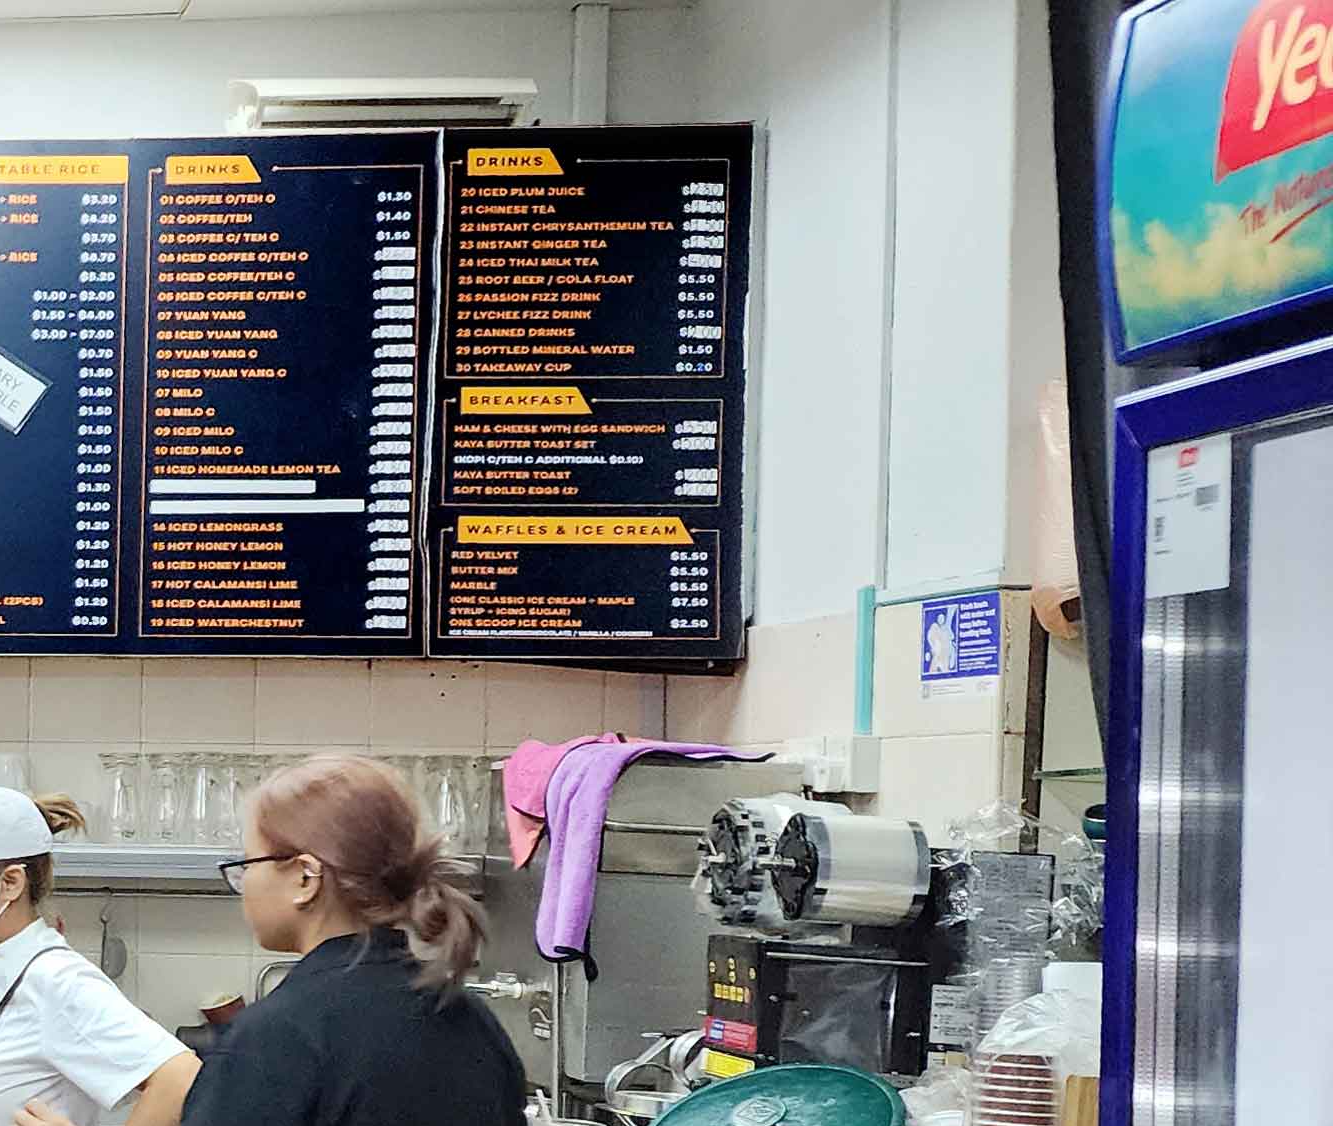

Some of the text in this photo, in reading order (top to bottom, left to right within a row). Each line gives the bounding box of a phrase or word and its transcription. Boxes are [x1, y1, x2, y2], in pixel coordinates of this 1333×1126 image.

[476, 156, 544, 167] DRINKS
[59, 164, 102, 176] RICE
[175, 164, 241, 175] DRINKS
[473, 362, 713, 373] TAKEAWAY CUP $0.20
[469, 395, 576, 406] BREAKFAST
[467, 525, 679, 536] WAFFLES & ICE CREAM
